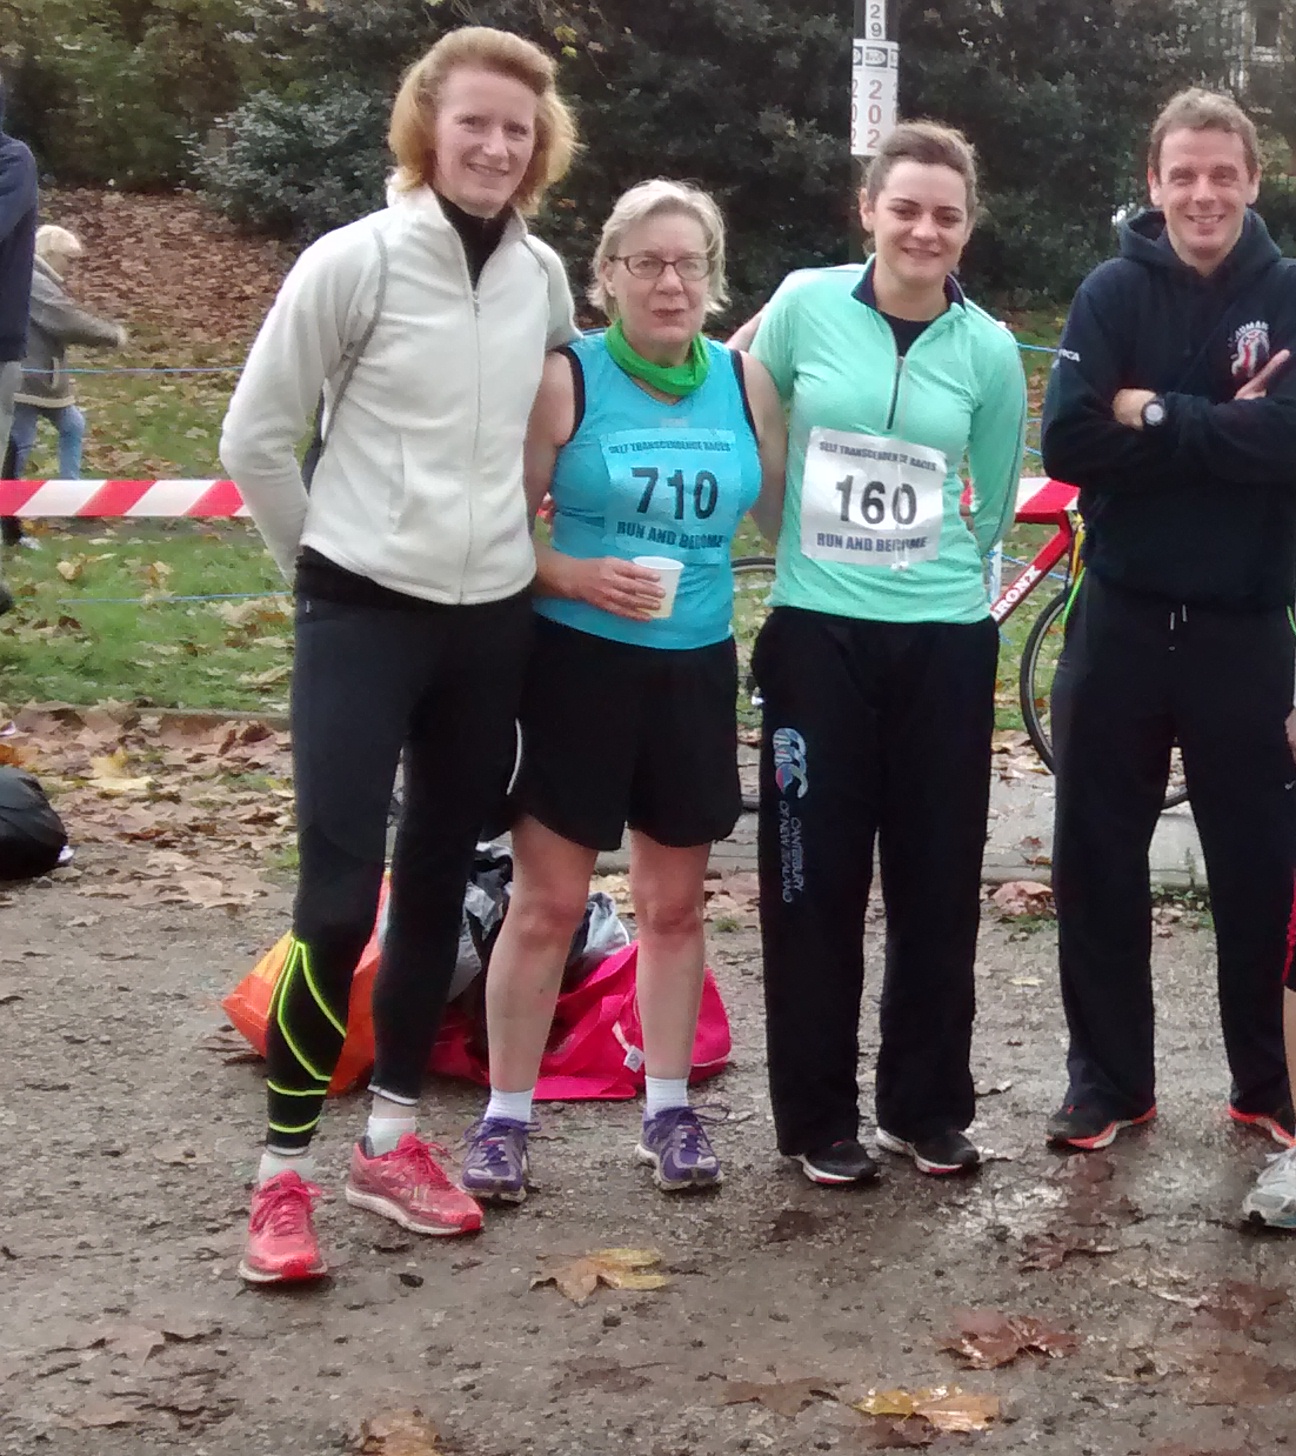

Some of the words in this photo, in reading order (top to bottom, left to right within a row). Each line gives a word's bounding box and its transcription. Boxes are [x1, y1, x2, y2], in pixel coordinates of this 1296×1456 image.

[630, 467, 719, 521] 710
[835, 474, 917, 526] 160
[616, 521, 645, 539] RUN
[647, 527, 677, 545] AND
[817, 532, 844, 547] RUN
[845, 536, 873, 552] AND
